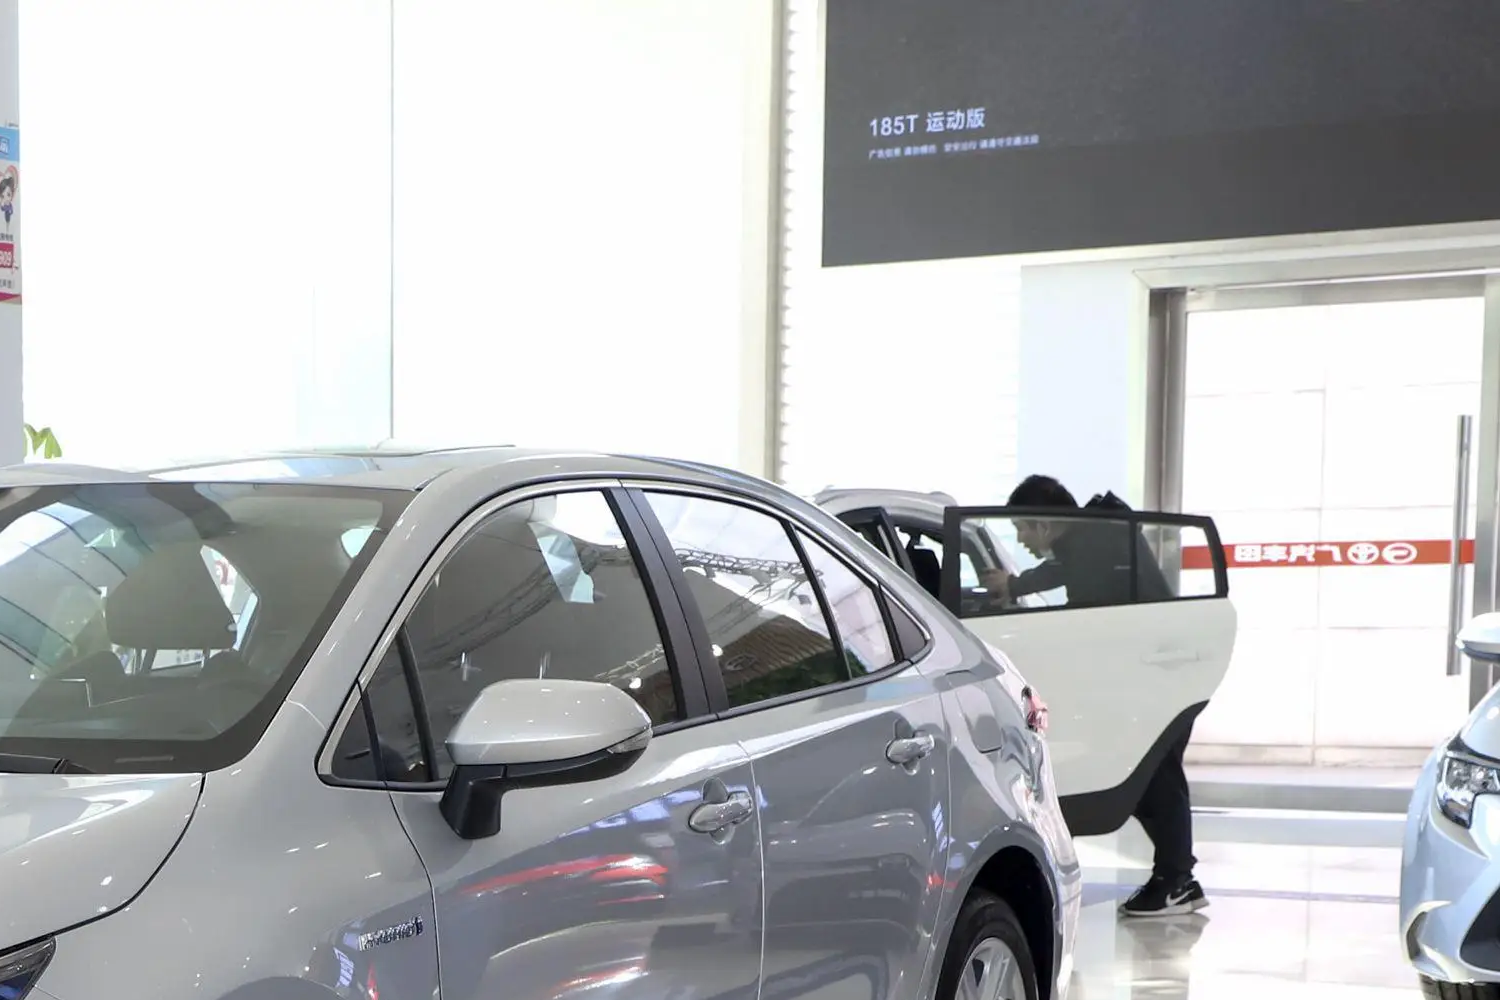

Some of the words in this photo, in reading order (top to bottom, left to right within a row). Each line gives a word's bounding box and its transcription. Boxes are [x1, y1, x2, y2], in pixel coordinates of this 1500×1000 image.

[869, 114, 919, 137] 185T
[926, 107, 986, 133] 运动版
